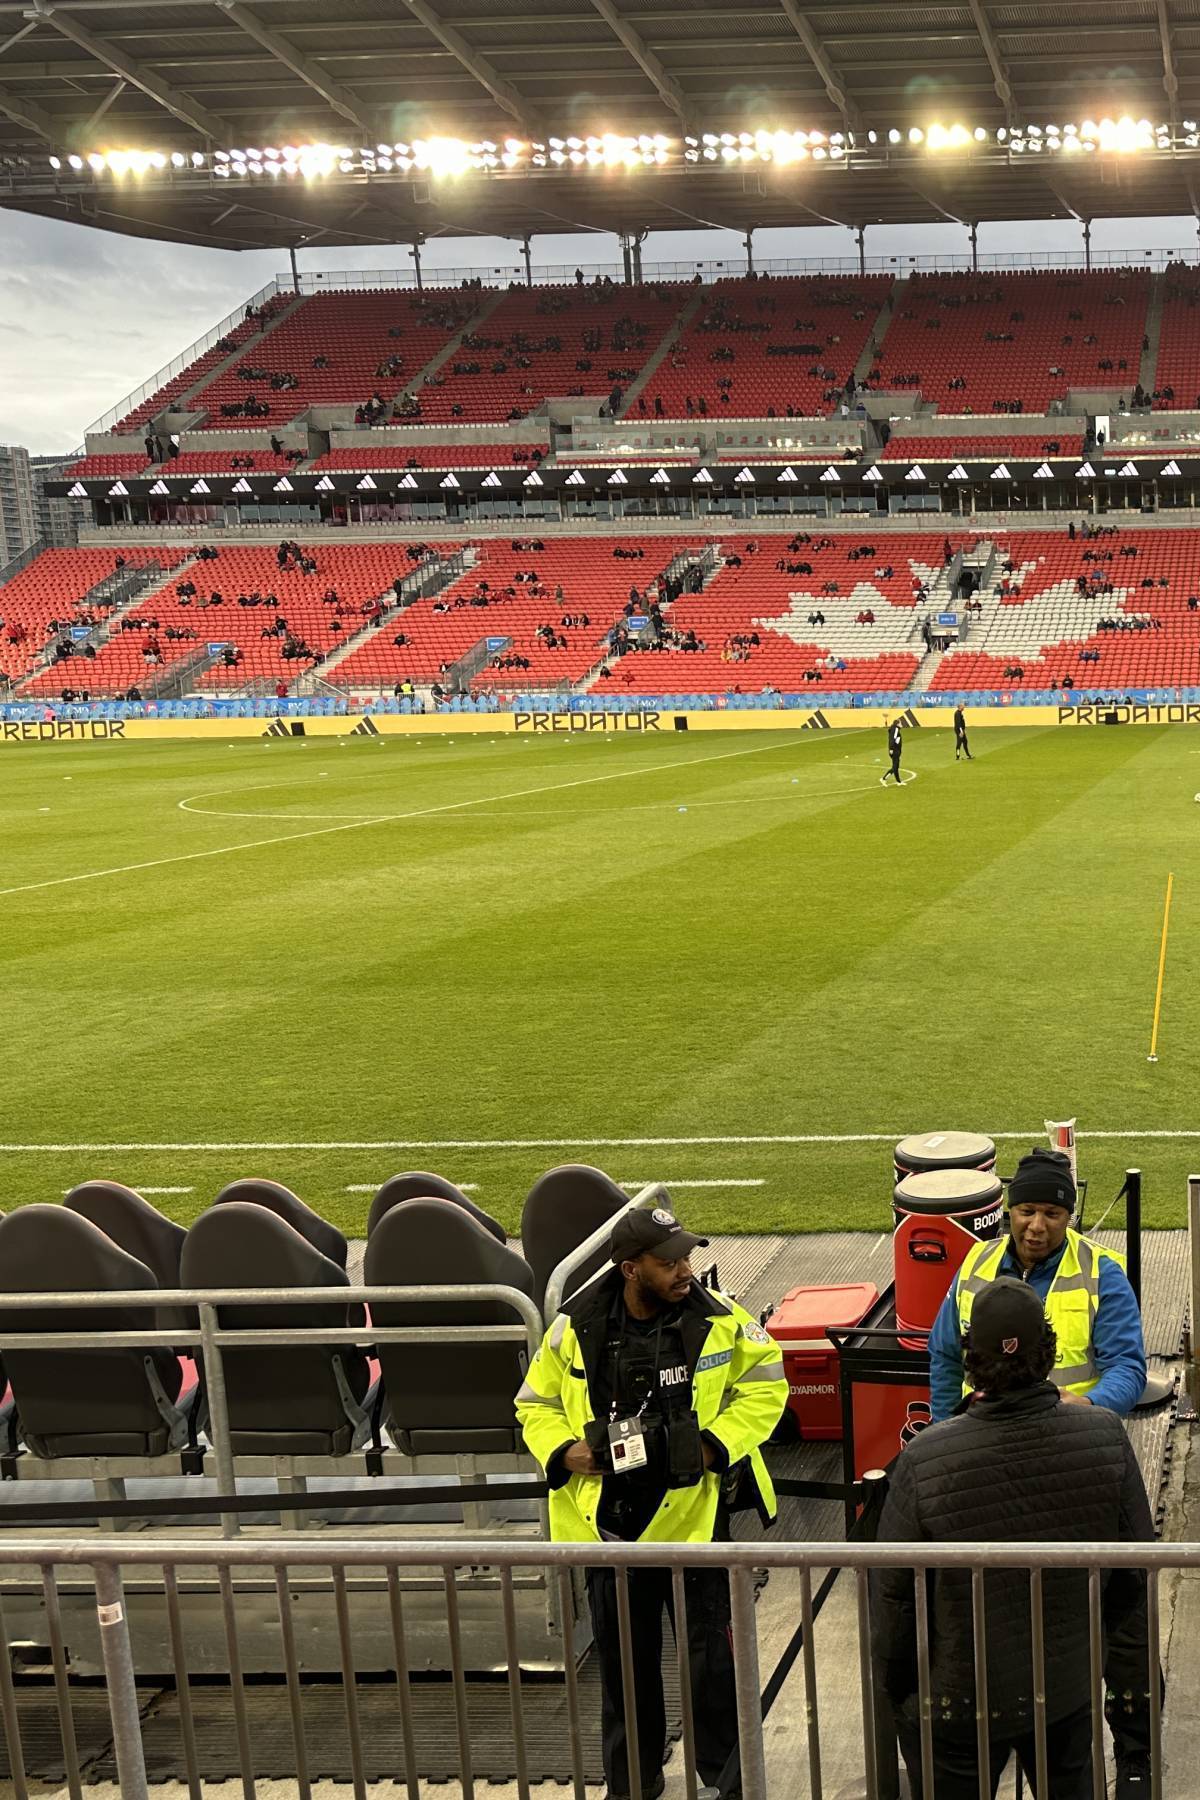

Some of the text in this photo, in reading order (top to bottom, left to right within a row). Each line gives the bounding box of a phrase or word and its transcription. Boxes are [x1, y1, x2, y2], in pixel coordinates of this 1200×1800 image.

[0, 720, 125, 741] REDATOR
[514, 712, 661, 731] PREDATOR
[700, 1349, 734, 1369] OLICE
[660, 1365, 689, 1387] POLICE
[790, 1384, 836, 1395] DYARMOR
